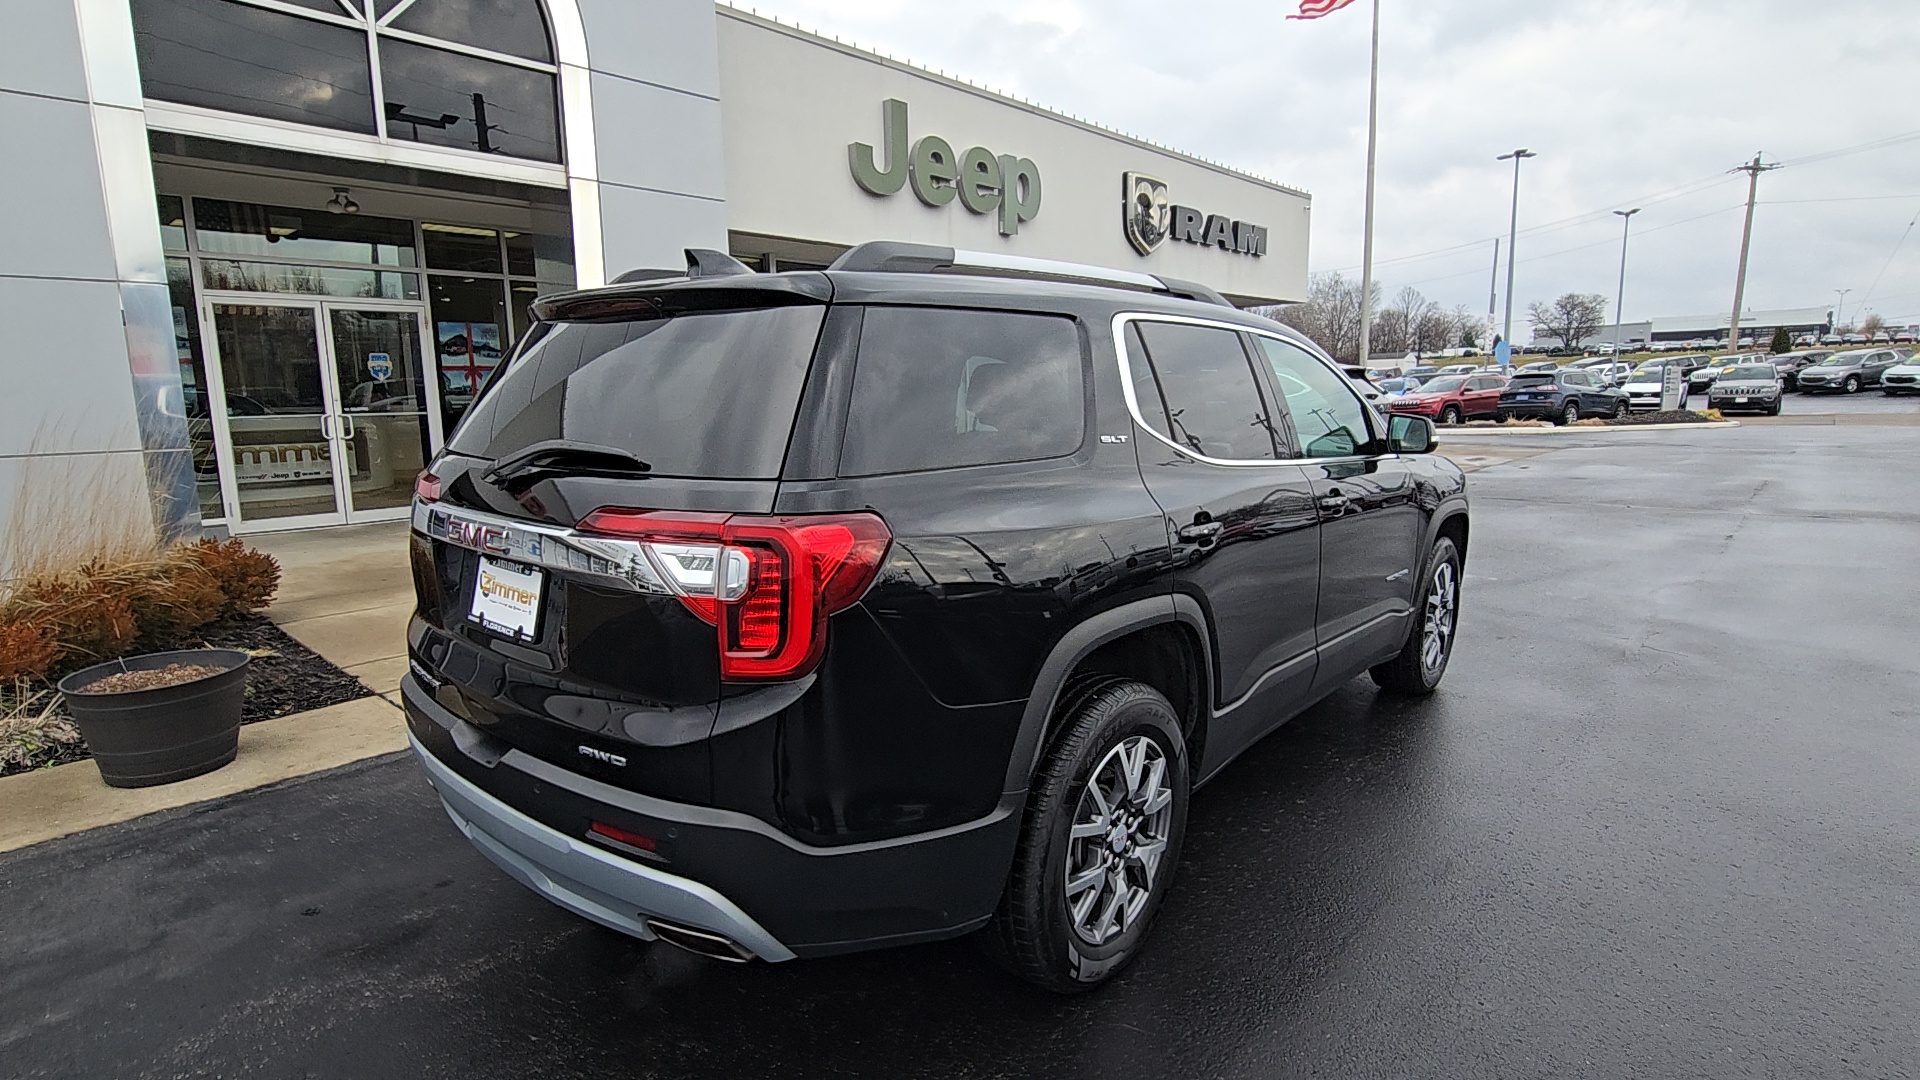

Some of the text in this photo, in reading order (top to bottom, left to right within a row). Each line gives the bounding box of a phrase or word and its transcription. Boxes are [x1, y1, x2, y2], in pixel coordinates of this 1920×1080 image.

[848, 98, 1041, 236] Jeep
[1169, 205, 1268, 256] RAM
[1100, 435, 1128, 443] SLT
[448, 520, 508, 552] GMC
[481, 573, 537, 606] Zimmer
[578, 745, 627, 767] AWD
